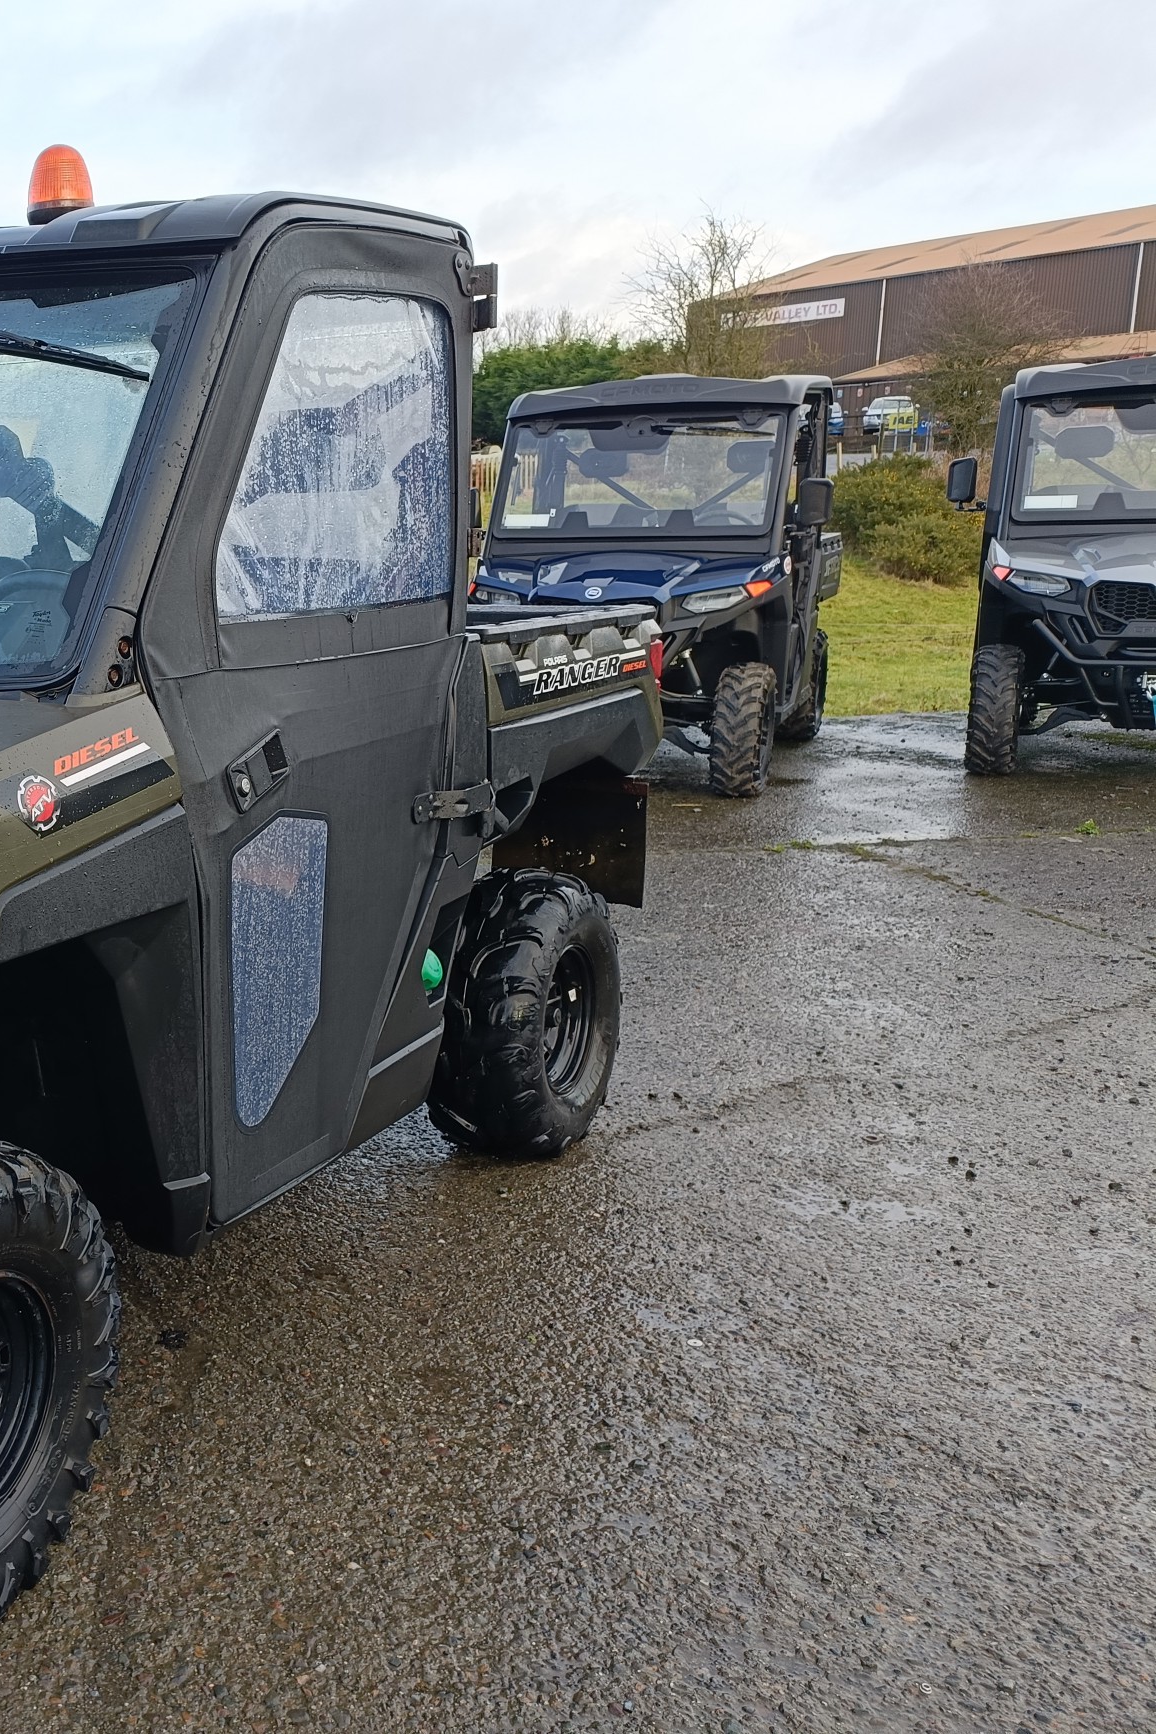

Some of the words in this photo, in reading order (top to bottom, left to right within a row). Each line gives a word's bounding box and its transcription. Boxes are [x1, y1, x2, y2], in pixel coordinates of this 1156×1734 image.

[765, 306, 811, 323] VALLEY
[816, 303, 841, 317] LTD.
[533, 654, 620, 695] RANGER
[544, 655, 568, 668] POLARIS
[622, 660, 647, 673] DIESEL
[54, 727, 139, 777] DIESEL
[31, 788, 52, 822] ATV
